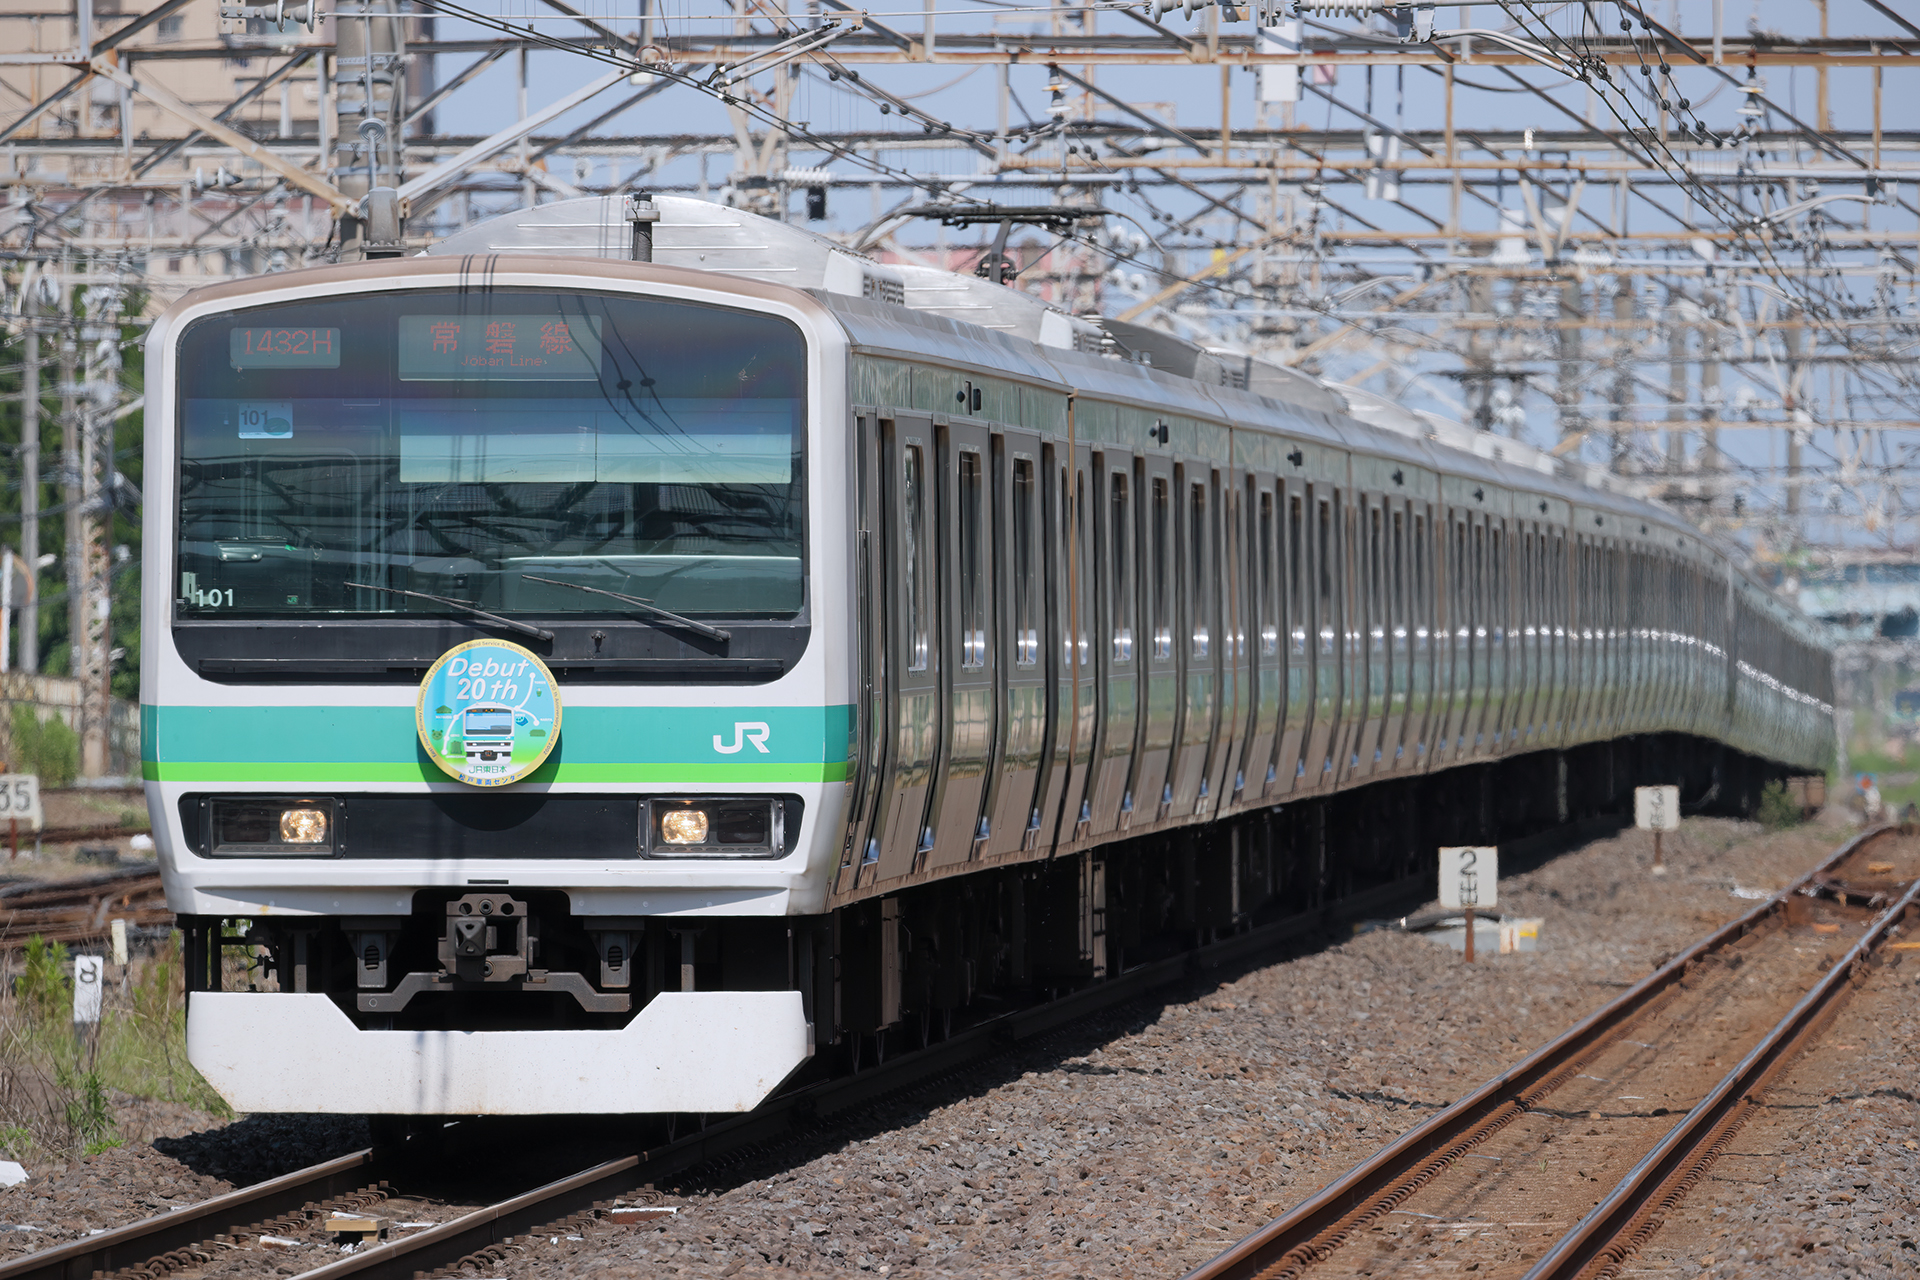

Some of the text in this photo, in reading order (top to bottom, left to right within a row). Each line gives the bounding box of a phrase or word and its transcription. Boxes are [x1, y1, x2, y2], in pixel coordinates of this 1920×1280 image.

[244, 330, 331, 355] 1432H
[430, 321, 572, 354] 常磐線
[510, 355, 542, 367] Line
[241, 410, 268, 426] 101
[195, 588, 233, 607] 101
[448, 657, 530, 677] Debut
[456, 677, 518, 700] 20 th
[713, 721, 770, 754] JR
[469, 765, 507, 774] JR東日本
